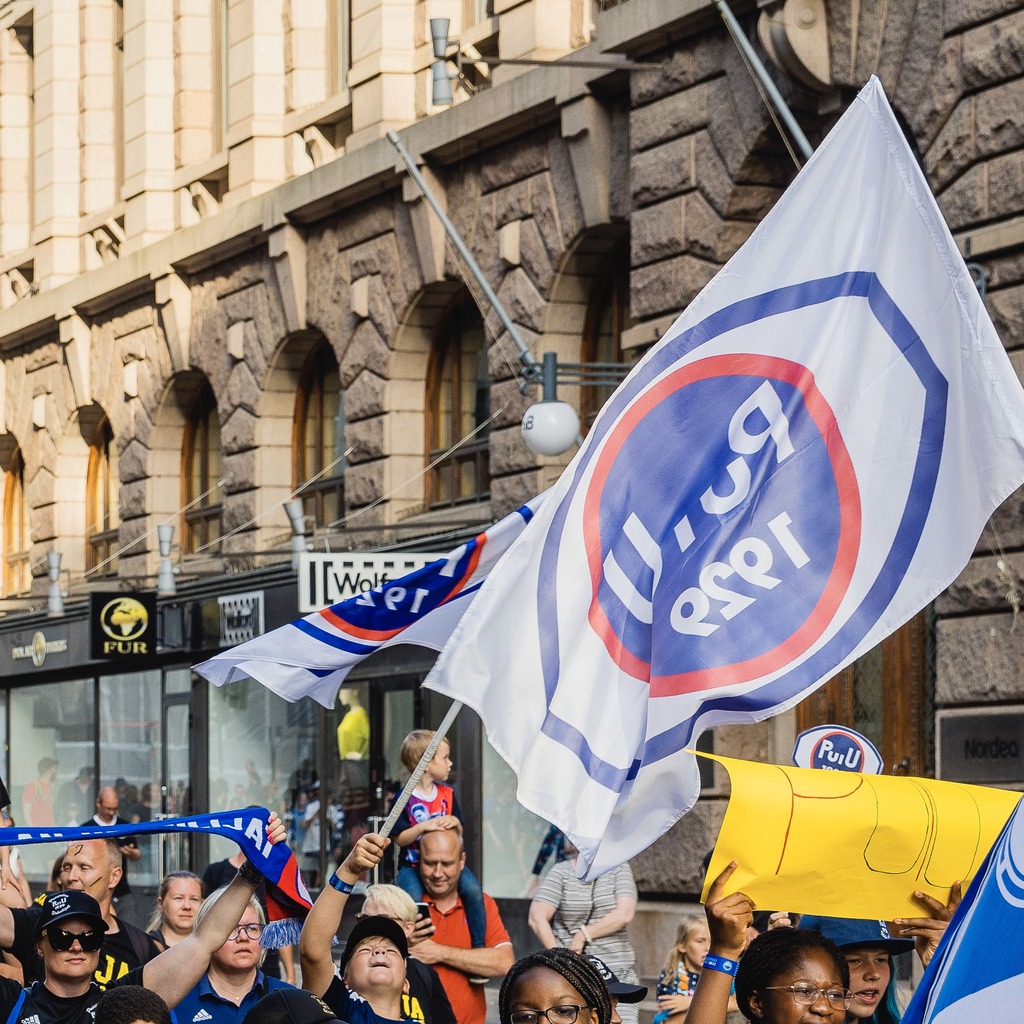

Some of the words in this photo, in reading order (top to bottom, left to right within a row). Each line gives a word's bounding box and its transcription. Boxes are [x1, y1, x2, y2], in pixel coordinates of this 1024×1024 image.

[334, 572, 389, 595] Wolf
[103, 641, 148, 654] FUR
[818, 739, 861, 768] PuiU
[965, 737, 1018, 759] Nordea
[95, 955, 130, 985] JA
